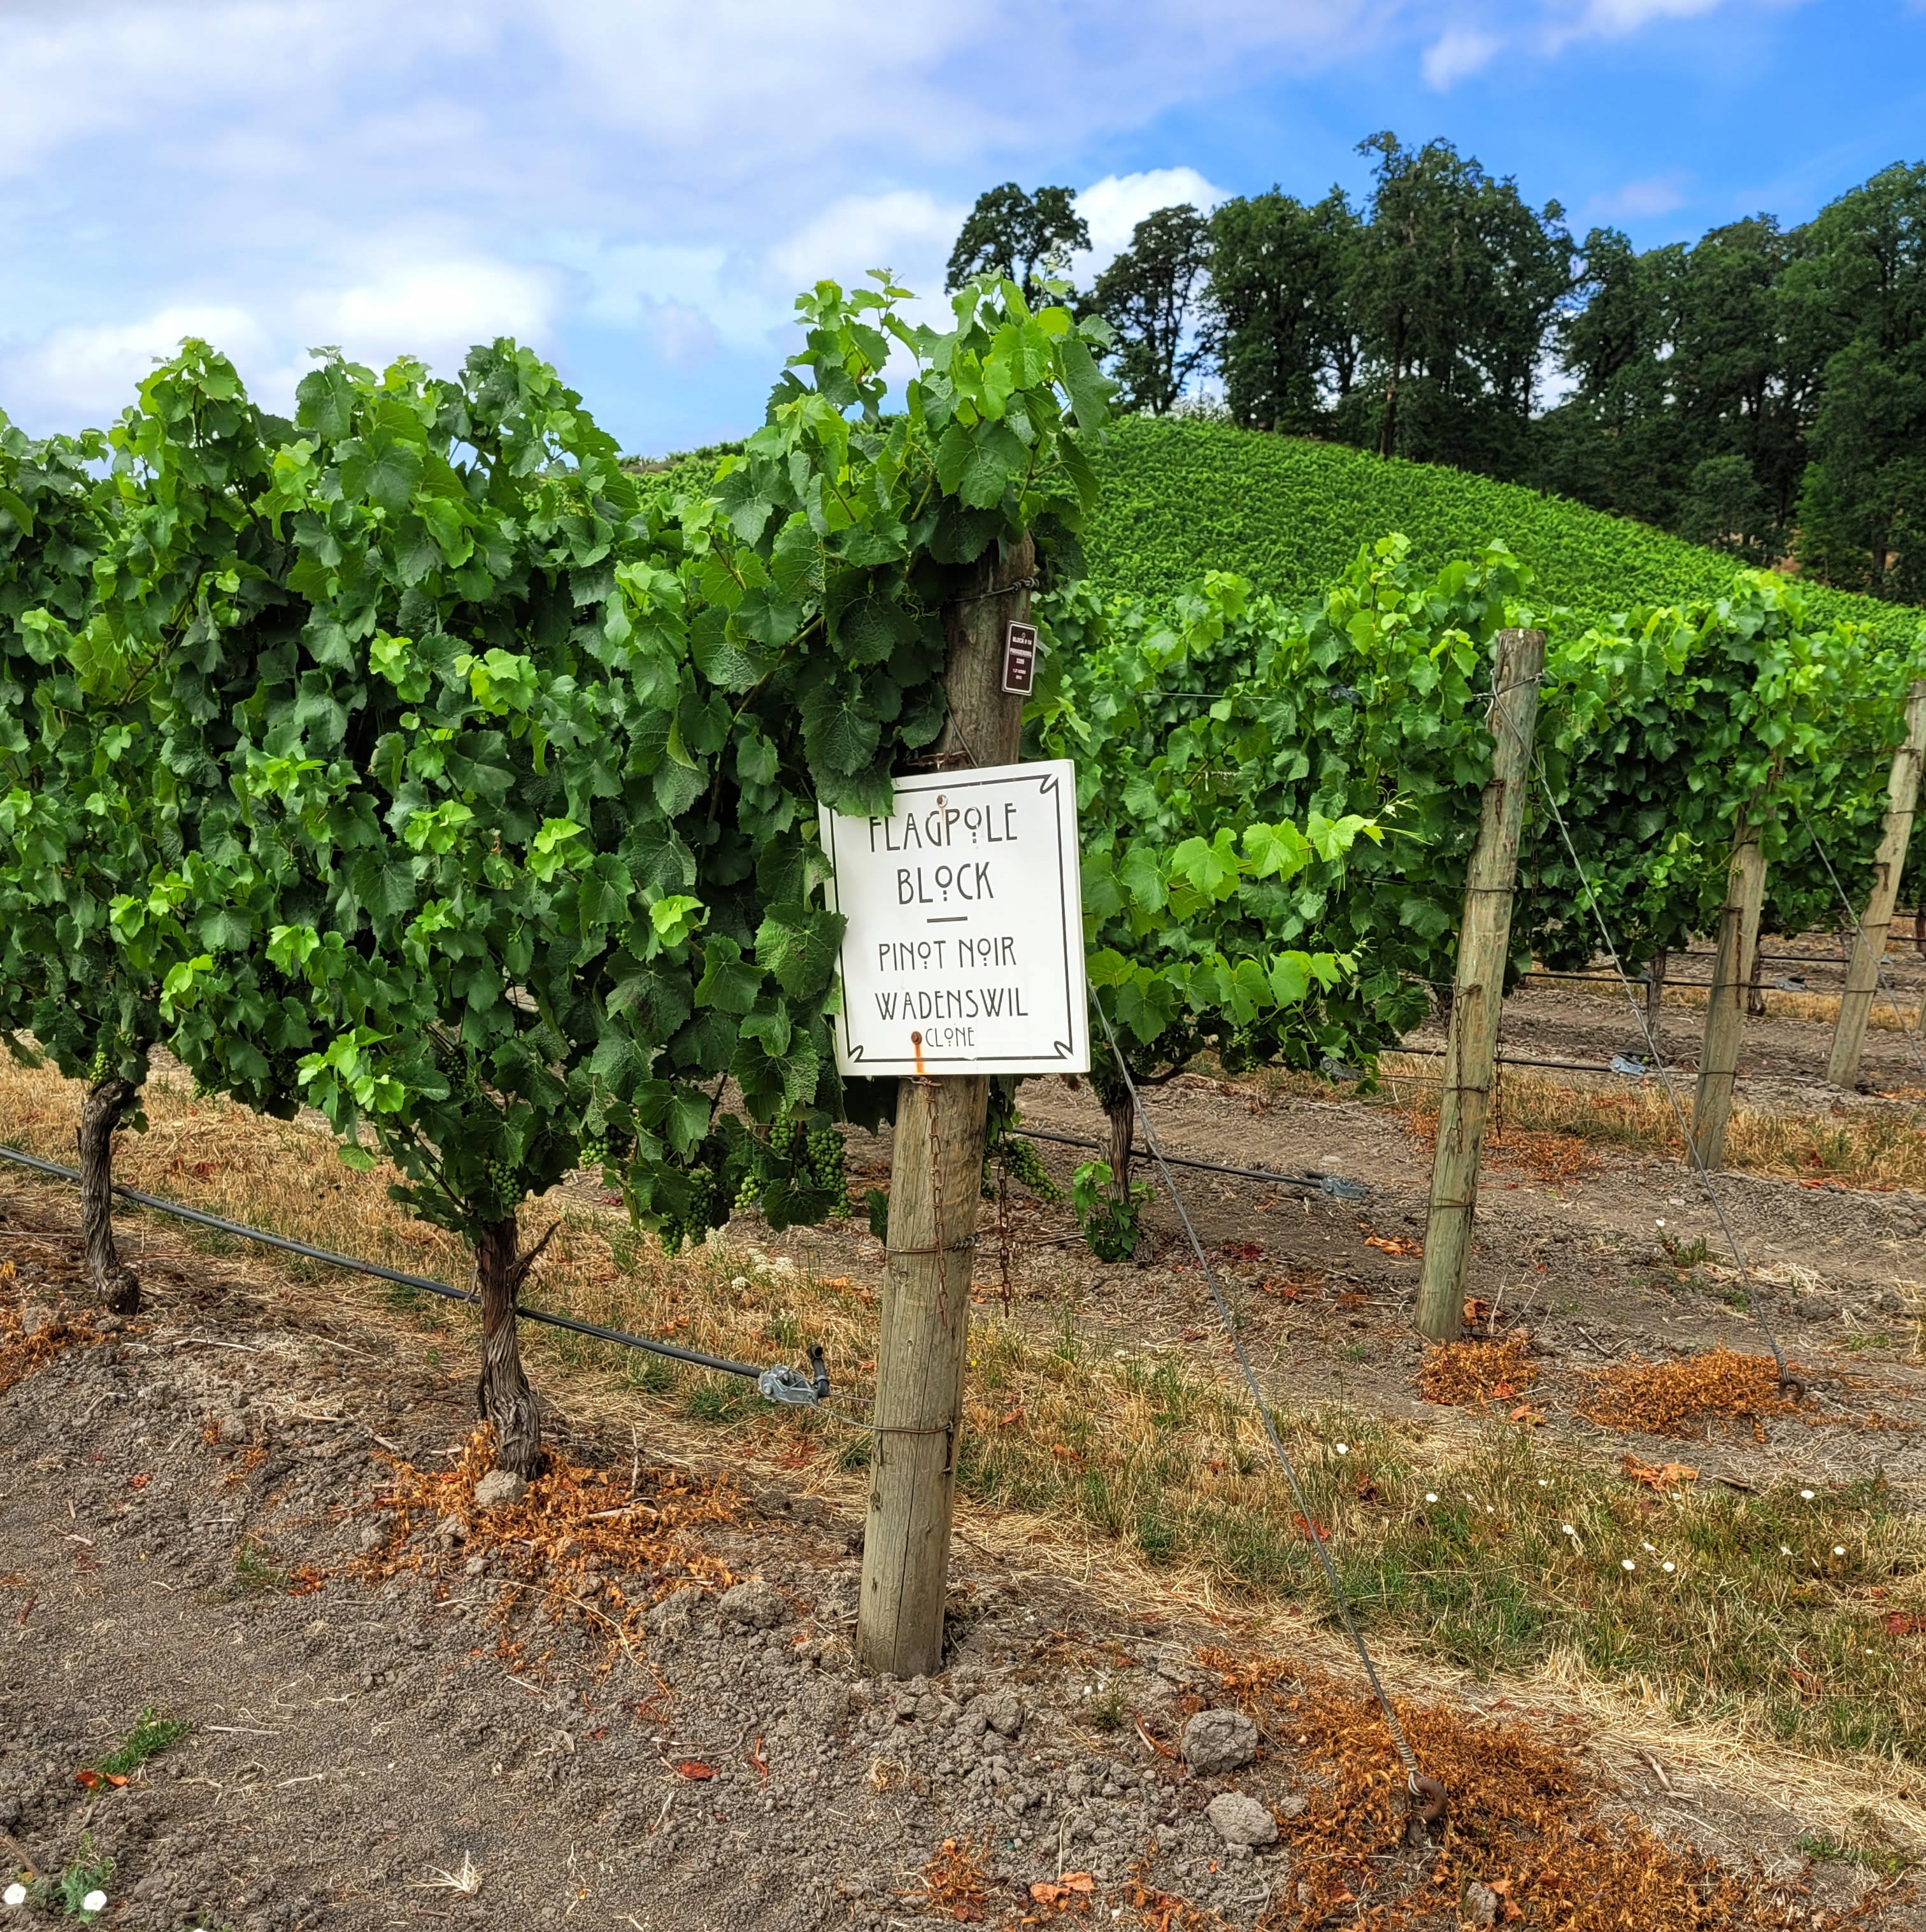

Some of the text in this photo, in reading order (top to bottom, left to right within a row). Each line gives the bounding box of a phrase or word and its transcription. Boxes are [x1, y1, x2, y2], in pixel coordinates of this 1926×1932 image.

[869, 802, 1018, 853] FLAGPOLE
[897, 862, 994, 905] BLOCK
[879, 937, 1016, 972] PINOT NOIR
[874, 987, 1029, 1020] WADENSWIL
[925, 1027, 974, 1047] CLONE
